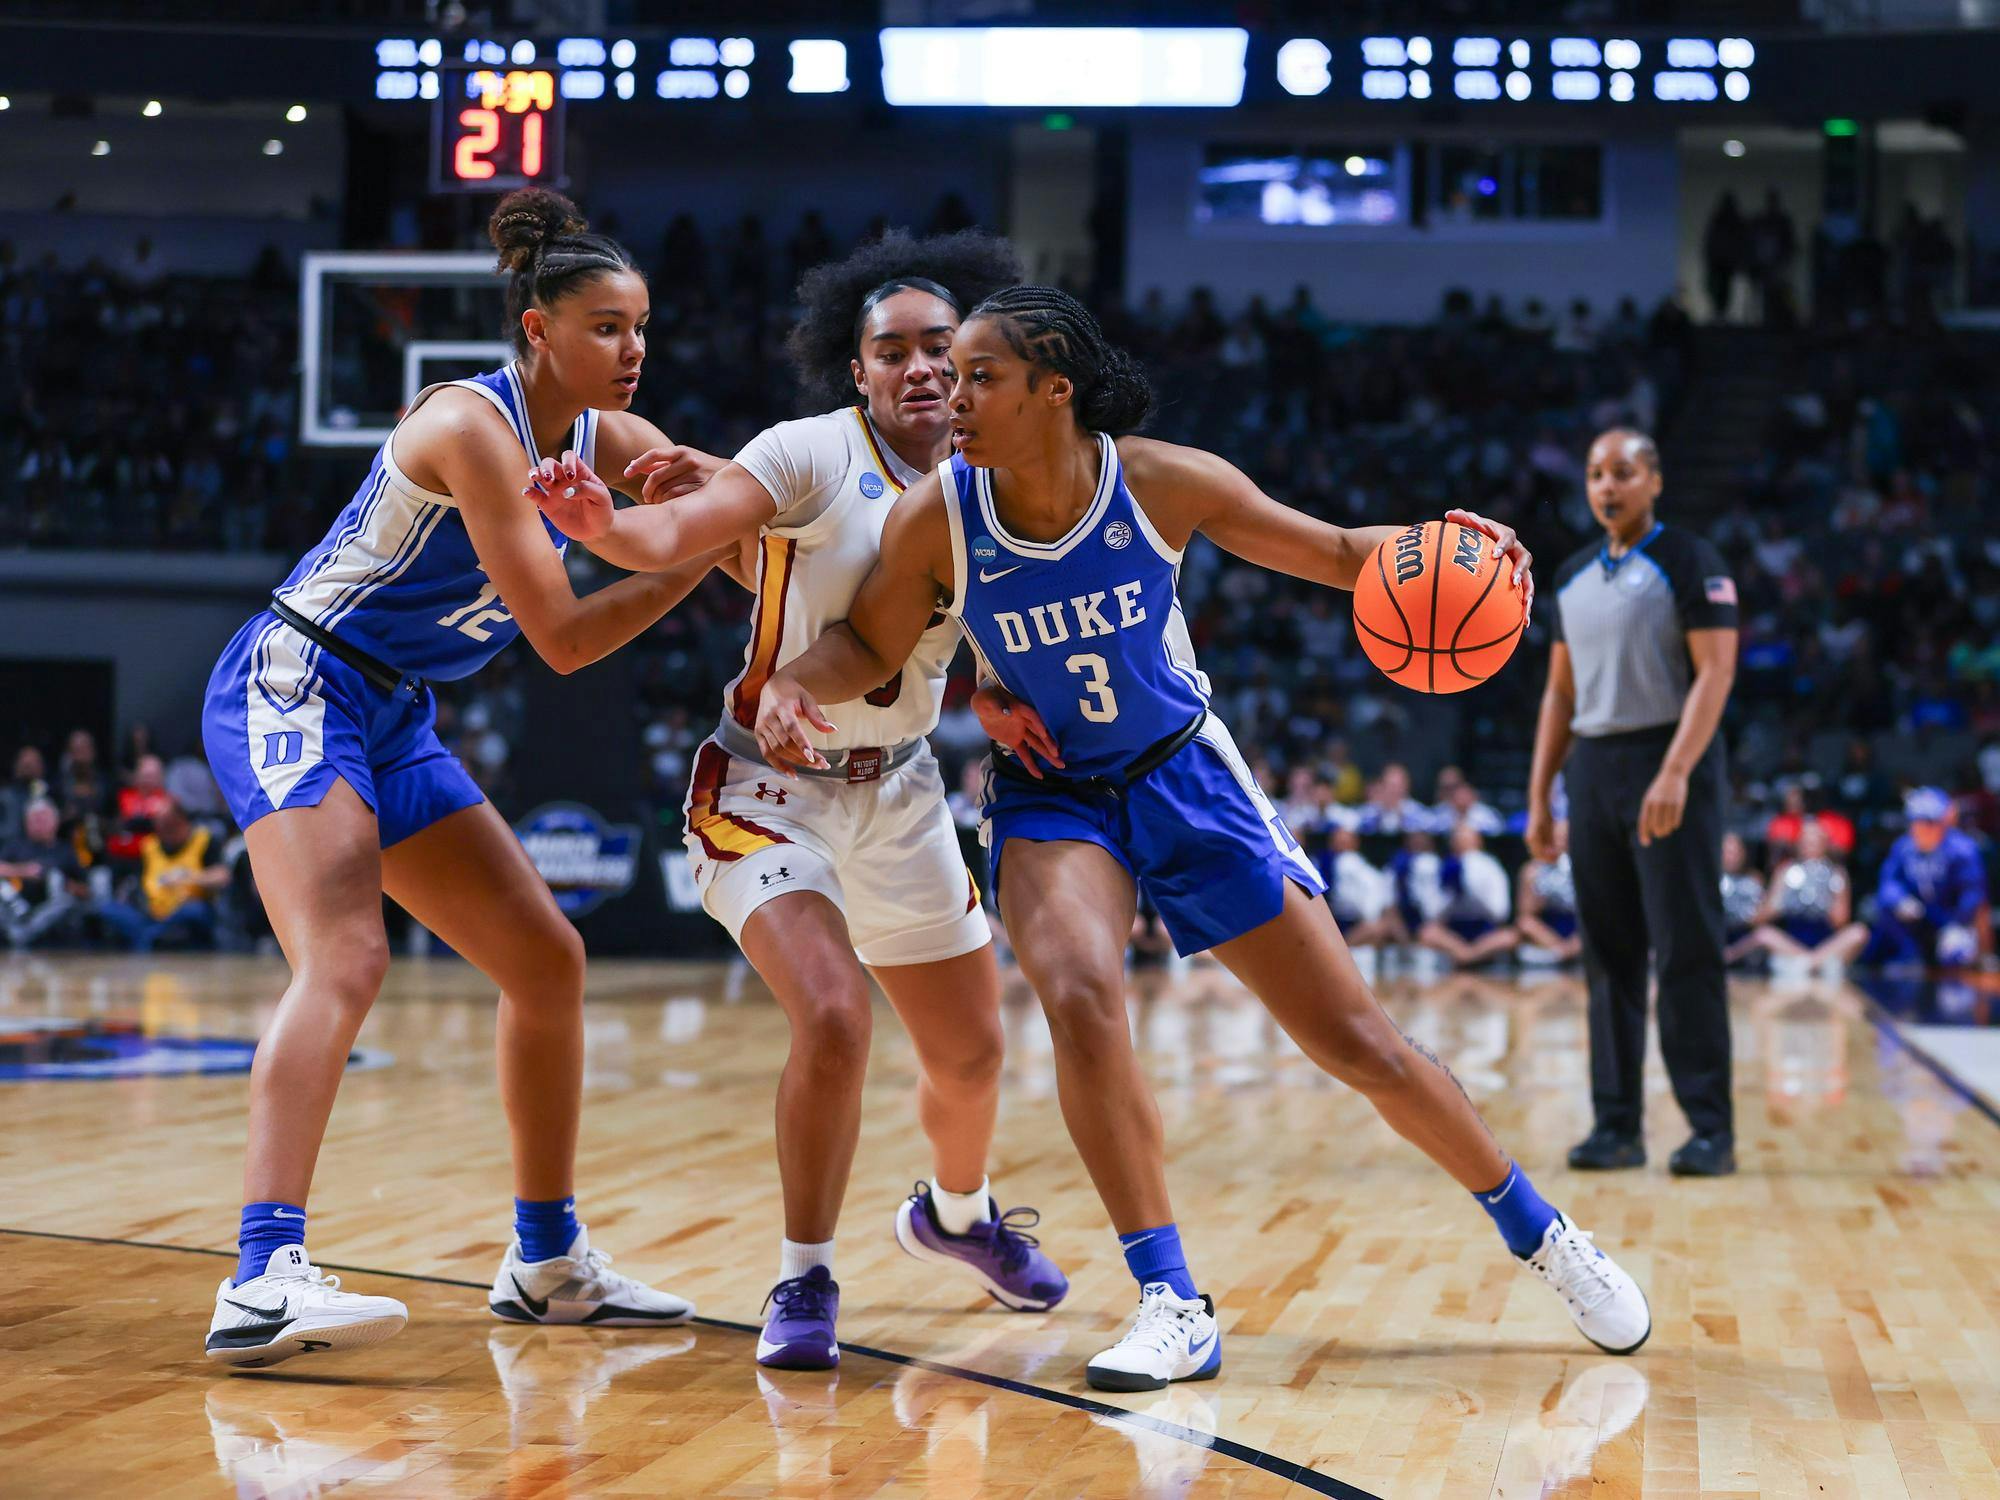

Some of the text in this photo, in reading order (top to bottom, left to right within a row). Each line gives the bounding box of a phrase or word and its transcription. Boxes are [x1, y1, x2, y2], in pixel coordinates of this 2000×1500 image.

[455, 109, 541, 178] 21
[975, 548, 996, 557] NCAA
[1453, 527, 1483, 574] NCA
[993, 580, 1147, 653] DUKE
[1065, 653, 1119, 723] 3
[261, 731, 303, 769] D
